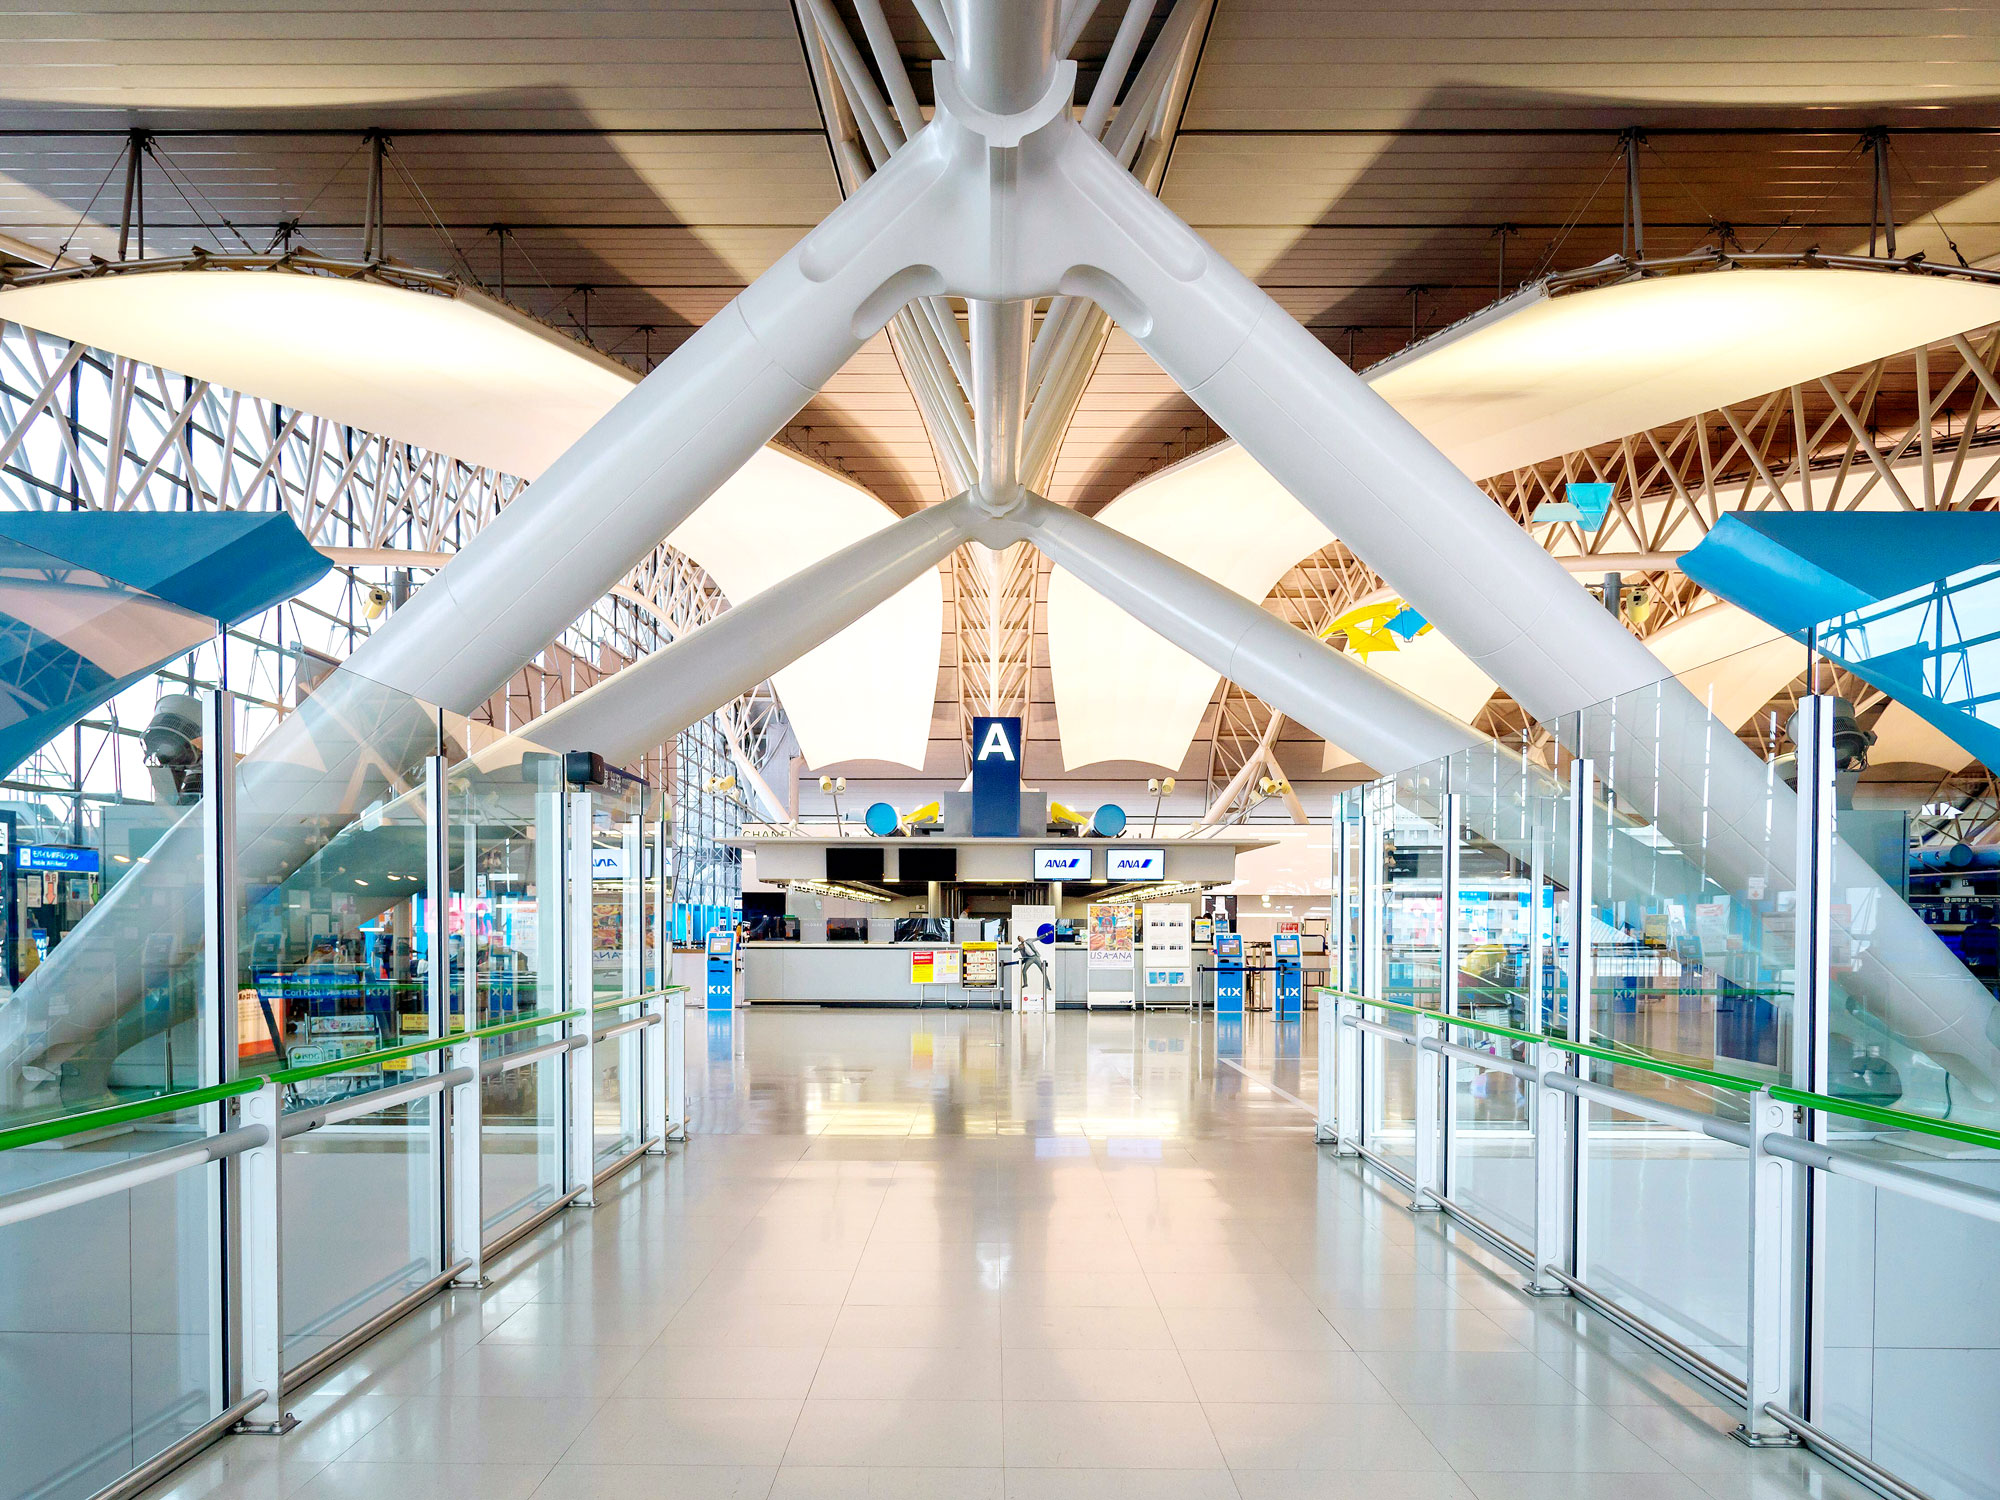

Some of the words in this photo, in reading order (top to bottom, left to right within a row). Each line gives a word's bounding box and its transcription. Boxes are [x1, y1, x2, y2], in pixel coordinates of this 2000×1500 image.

[977, 722, 1016, 761] A
[1045, 860, 1067, 868] ANA
[1117, 860, 1140, 868] ANA
[708, 985, 731, 995] KIX
[1218, 987, 1241, 997] KIX
